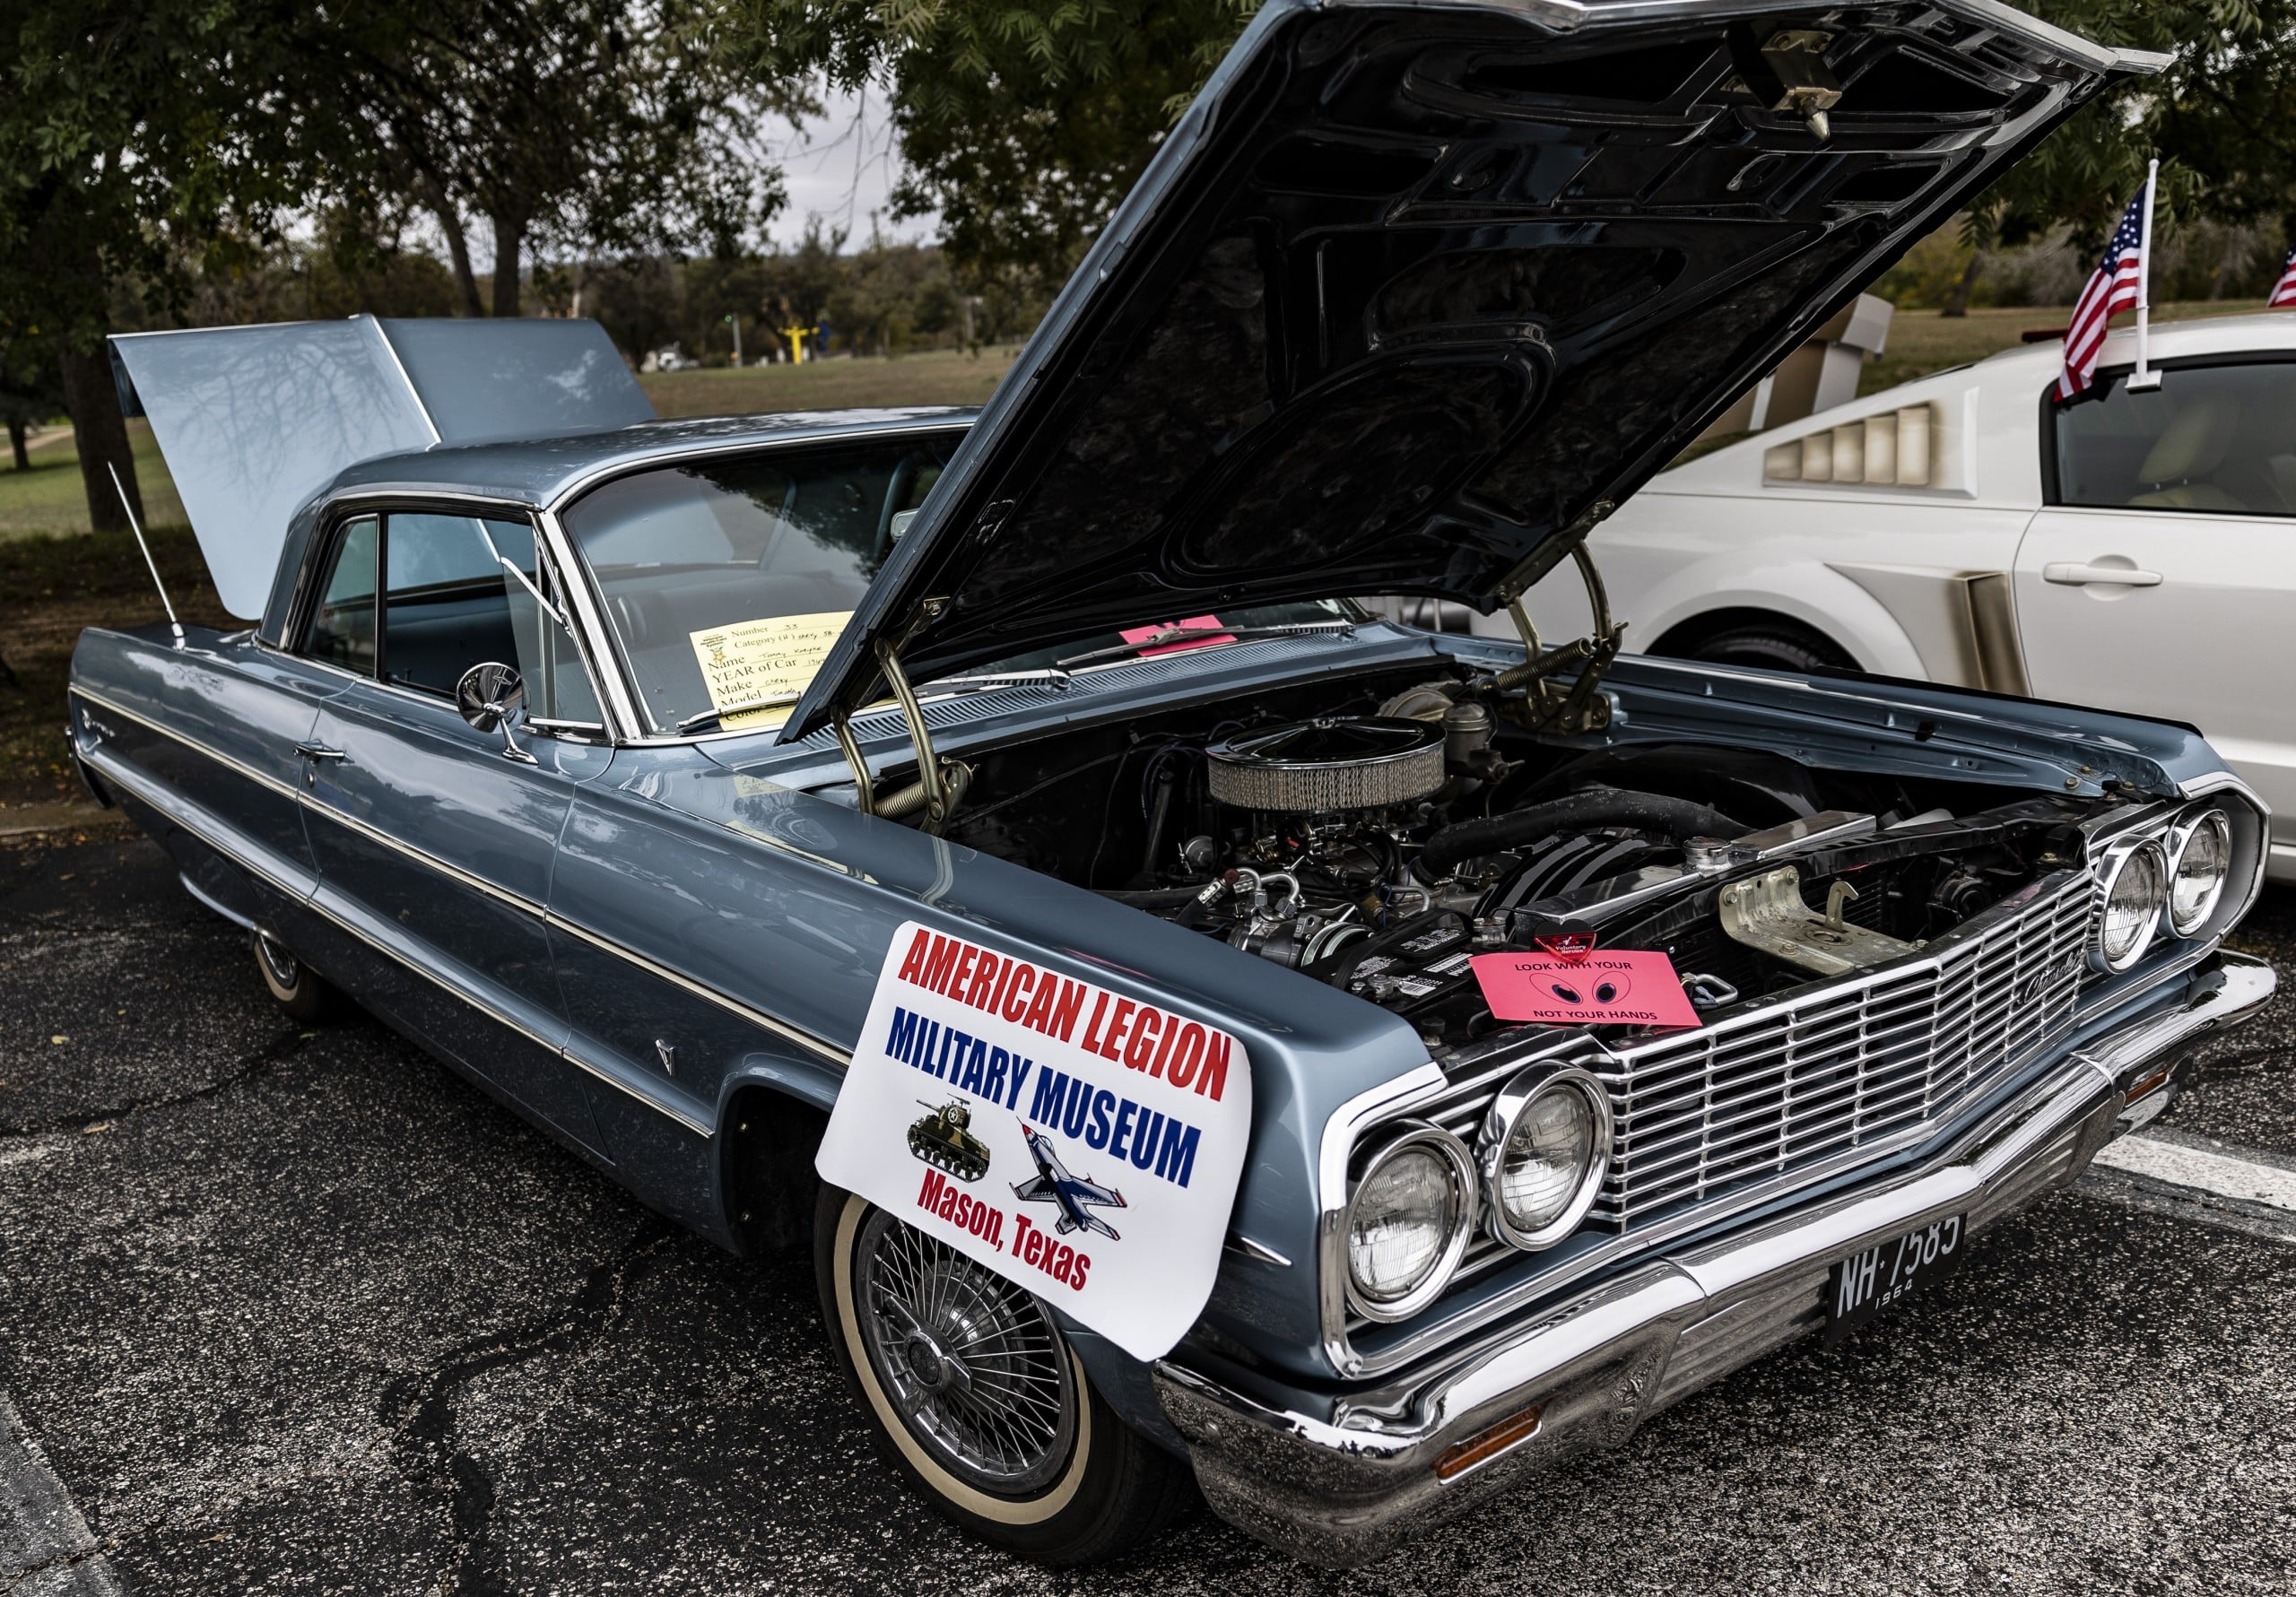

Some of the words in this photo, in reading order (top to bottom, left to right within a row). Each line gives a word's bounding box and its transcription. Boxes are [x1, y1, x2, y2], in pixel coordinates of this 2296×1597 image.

[731, 626, 769, 638] Number
[734, 635, 776, 649] Category
[708, 655, 745, 672] Name
[712, 665, 755, 683] YEAR
[758, 660, 772, 673] of
[775, 658, 797, 669] Car
[717, 680, 752, 697] Make
[720, 690, 761, 707] Model
[1515, 962, 1552, 971] LOOK
[1594, 961, 1633, 970] YOUR
[897, 929, 1087, 1044] AMERICAN
[1081, 990, 1231, 1102] LEGION
[1534, 1010, 1564, 1019] NOT
[1566, 1010, 1605, 1020] YOUR
[1607, 1011, 1658, 1020] HANDS
[884, 1006, 1033, 1112] MILITARY
[1029, 1065, 1202, 1189] MUSEUM
[917, 1167, 1004, 1253] Mason,
[1012, 1213, 1091, 1291] Texas
[1875, 1279, 1913, 1310] 1964
